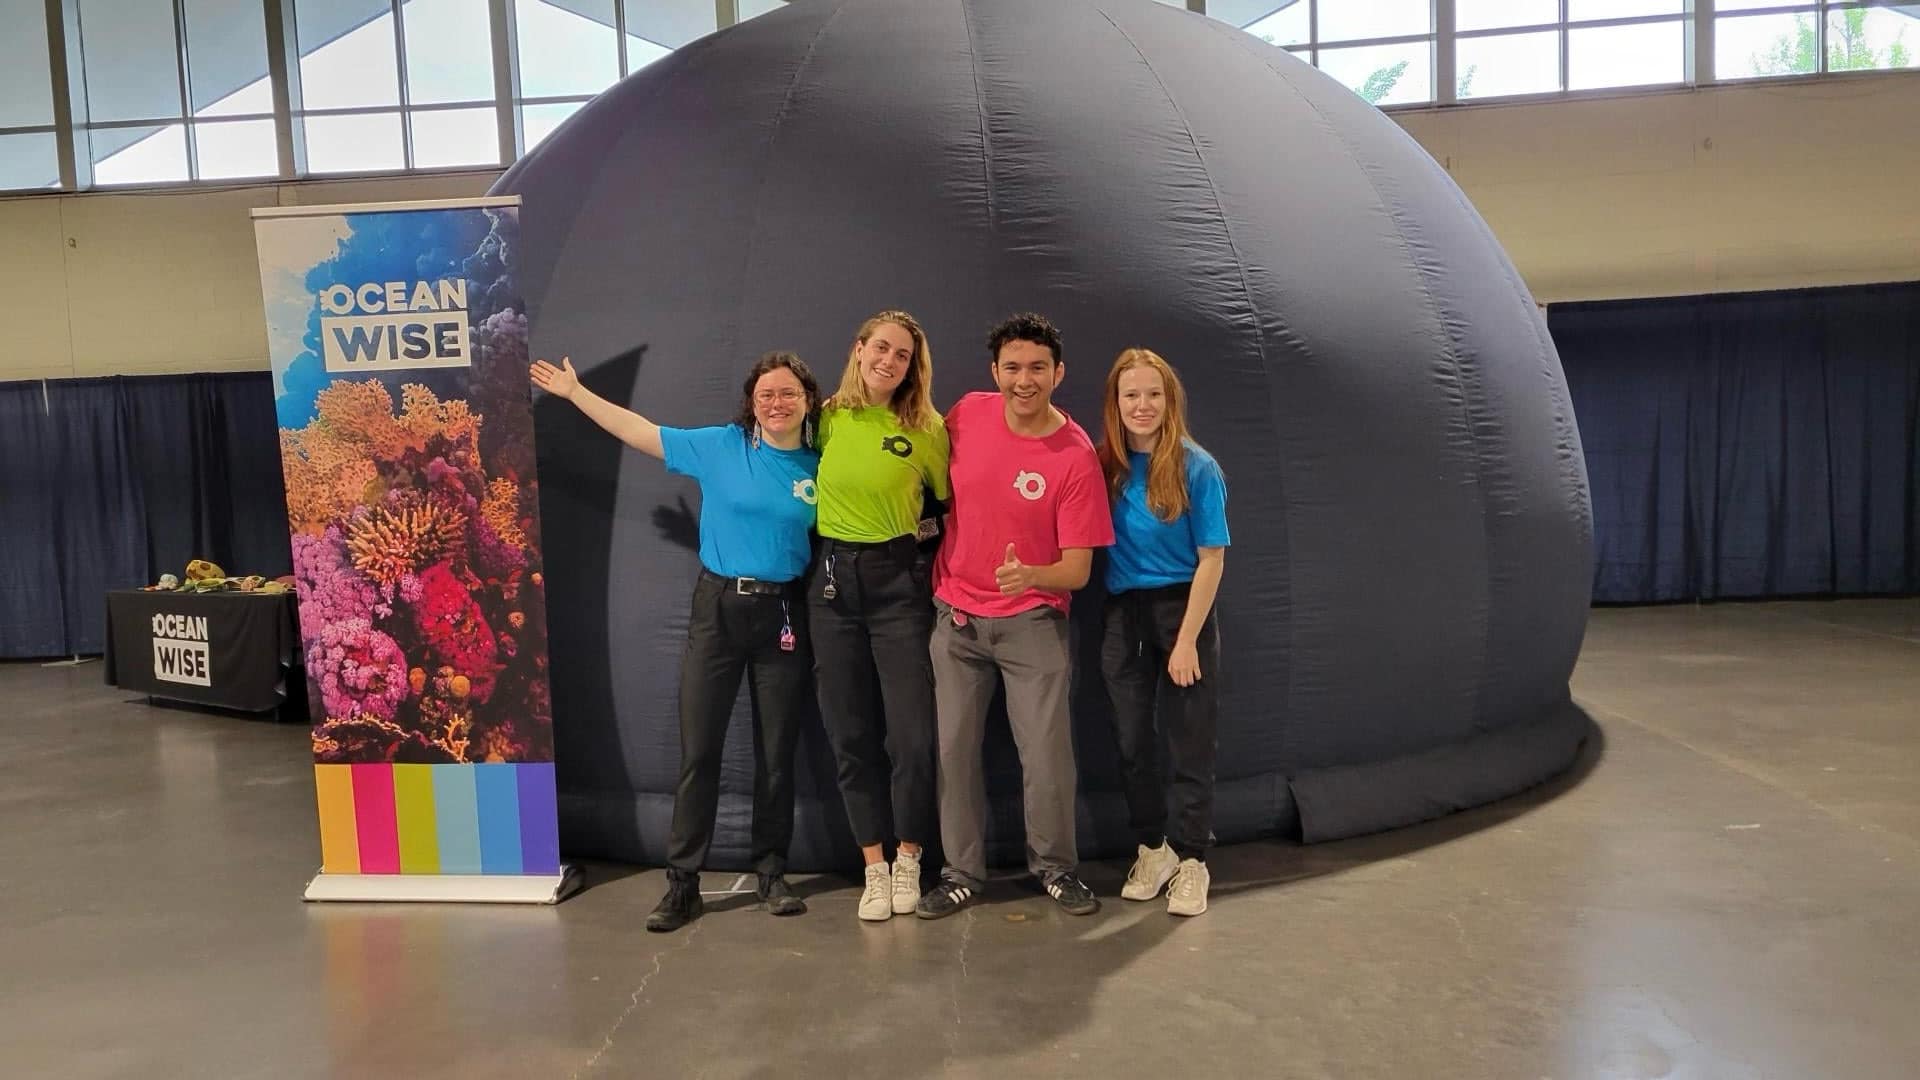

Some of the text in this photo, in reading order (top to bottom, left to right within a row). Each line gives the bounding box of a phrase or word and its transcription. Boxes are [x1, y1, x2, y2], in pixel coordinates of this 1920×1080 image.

[320, 279, 467, 314] OCEAN
[332, 322, 462, 362] WISE
[152, 613, 208, 640] OCEAN
[157, 646, 206, 678] WISE
